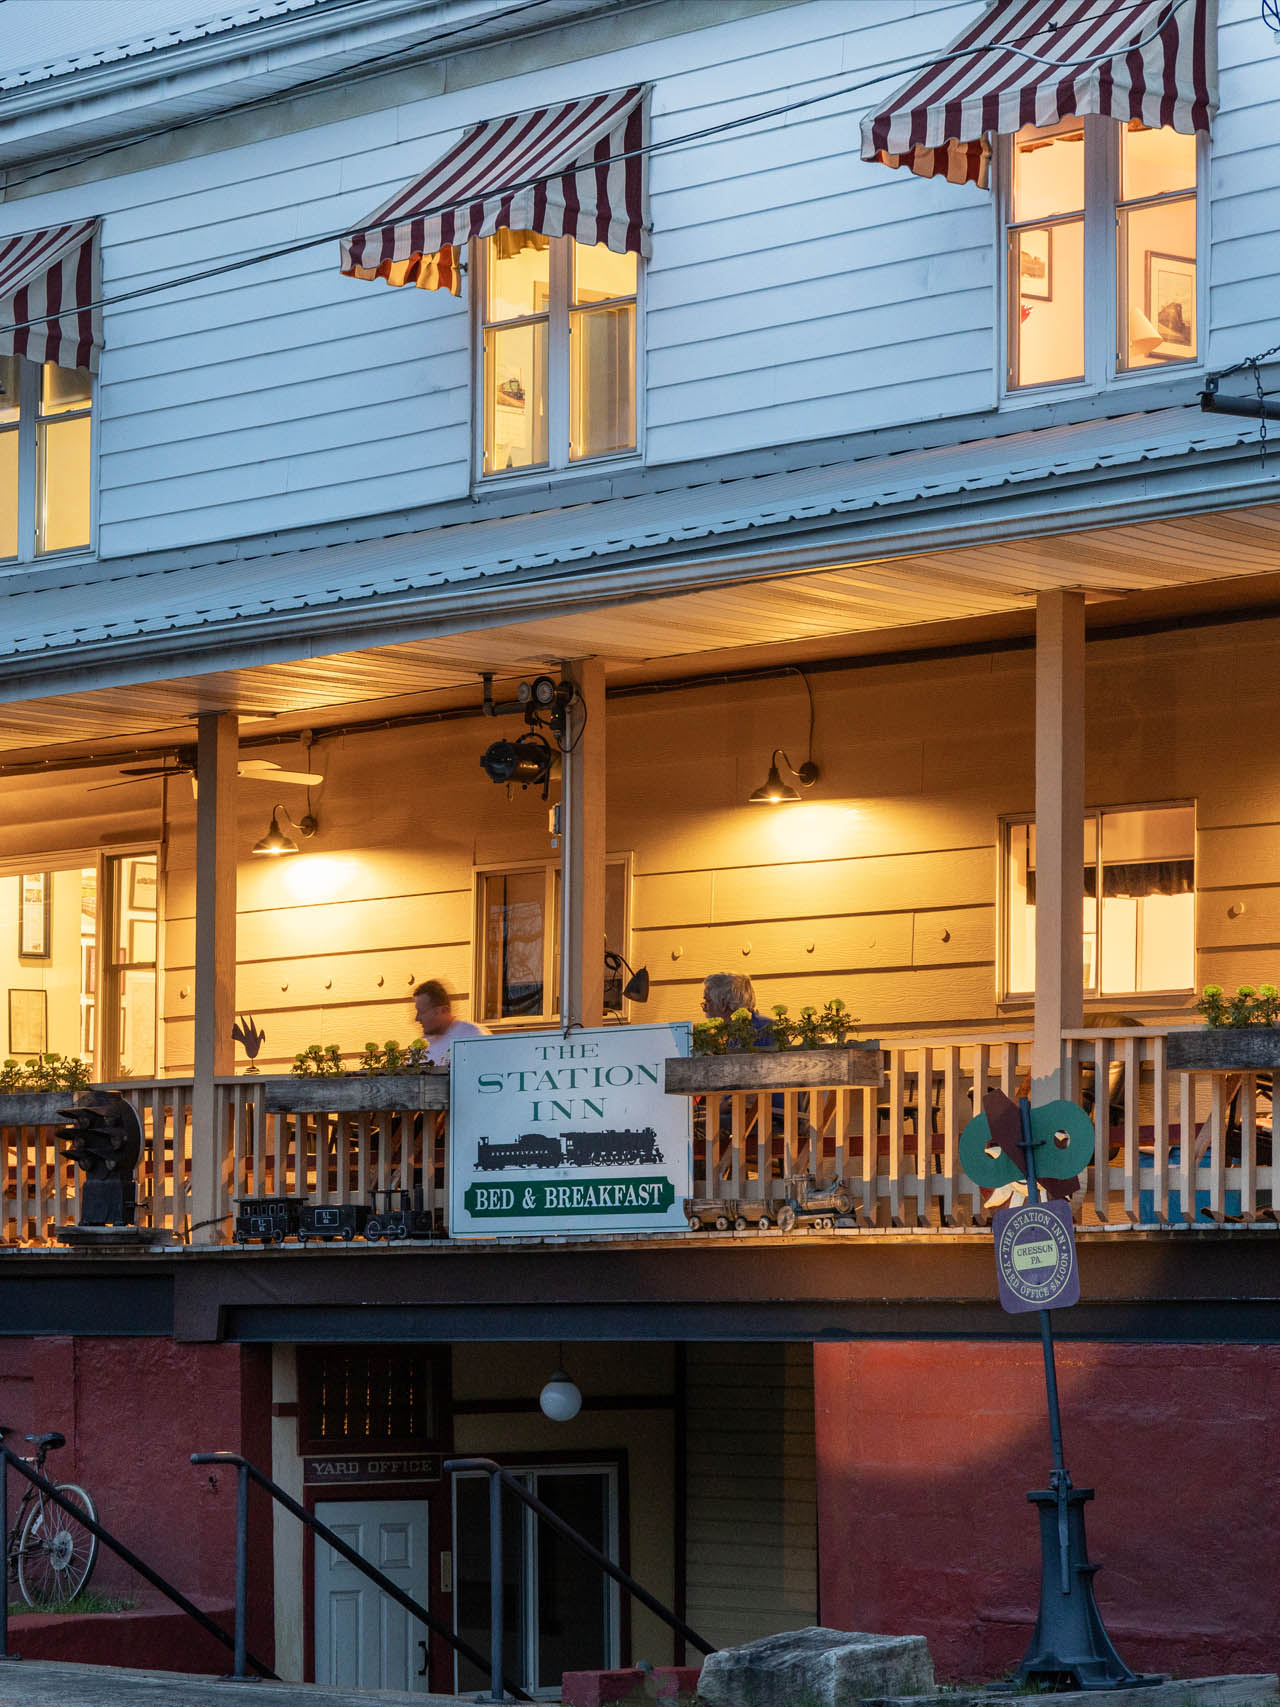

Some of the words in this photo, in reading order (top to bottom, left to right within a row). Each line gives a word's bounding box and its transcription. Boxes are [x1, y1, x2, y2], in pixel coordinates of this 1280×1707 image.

[535, 1043, 599, 1060] THE
[477, 1063, 661, 1094] STATION
[529, 1097, 608, 1121] INN
[475, 1188, 515, 1211] BED
[522, 1187, 536, 1210] &
[544, 1183, 663, 1209] BREAKFAST
[1003, 1229, 1015, 1252] THE
[1013, 1212, 1051, 1230] STATION
[1051, 1222, 1066, 1245] INN
[1017, 1243, 1054, 1257] CRESSON
[1003, 1260, 1020, 1288] YARD
[1020, 1285, 1050, 1298] OFFICE
[1050, 1252, 1068, 1291] SALOON
[312, 1462, 360, 1475] YARD
[368, 1460, 433, 1473] OFFICE
